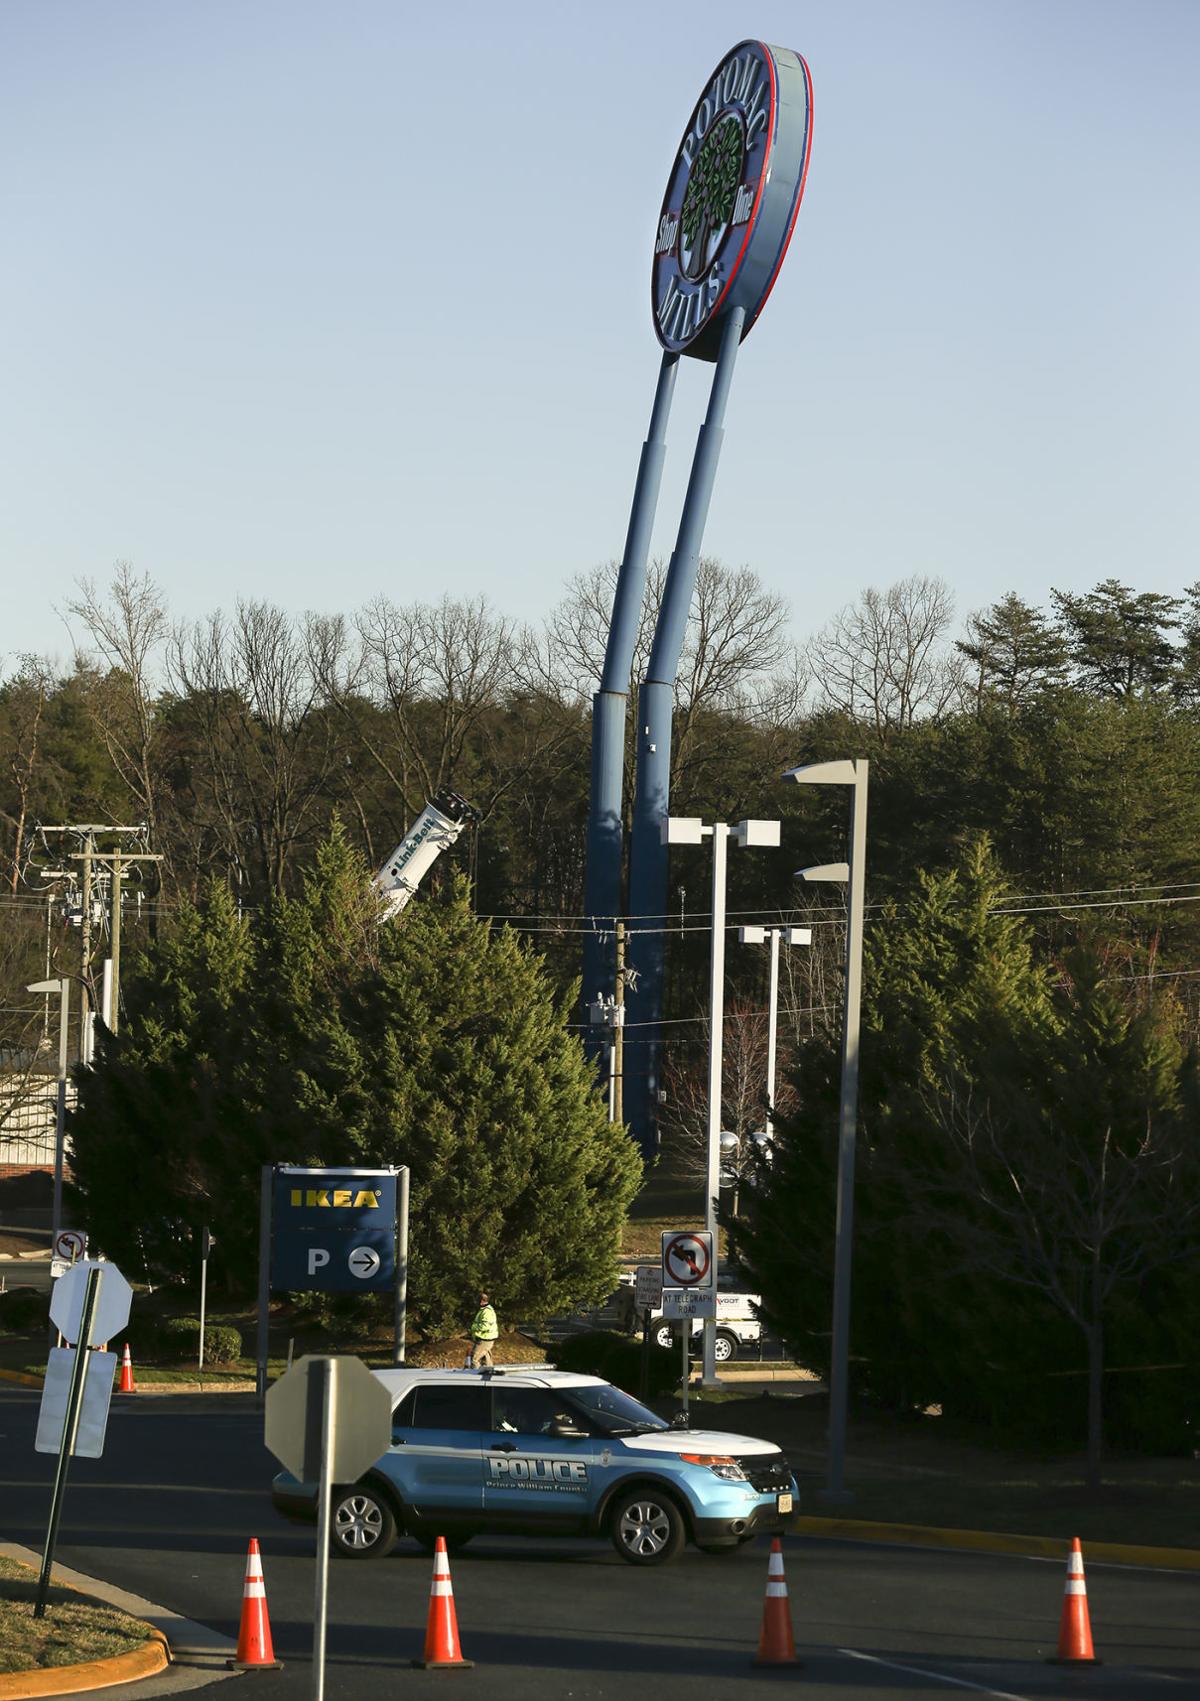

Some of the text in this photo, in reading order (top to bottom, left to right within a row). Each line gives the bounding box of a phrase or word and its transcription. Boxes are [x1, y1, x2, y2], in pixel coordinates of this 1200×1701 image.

[681, 54, 769, 169] POTOMAC
[731, 184, 754, 226] Dine
[656, 212, 679, 257] Shop
[656, 261, 723, 341] MILLS
[395, 818, 435, 869] Link-Belt
[290, 1189, 379, 1208] IKEA
[308, 1248, 330, 1276] P
[674, 1294, 712, 1303] TELEGRAPH
[678, 1305, 697, 1314] ROAD
[489, 1458, 588, 1483] POLICE
[517, 1482, 553, 1491] William
